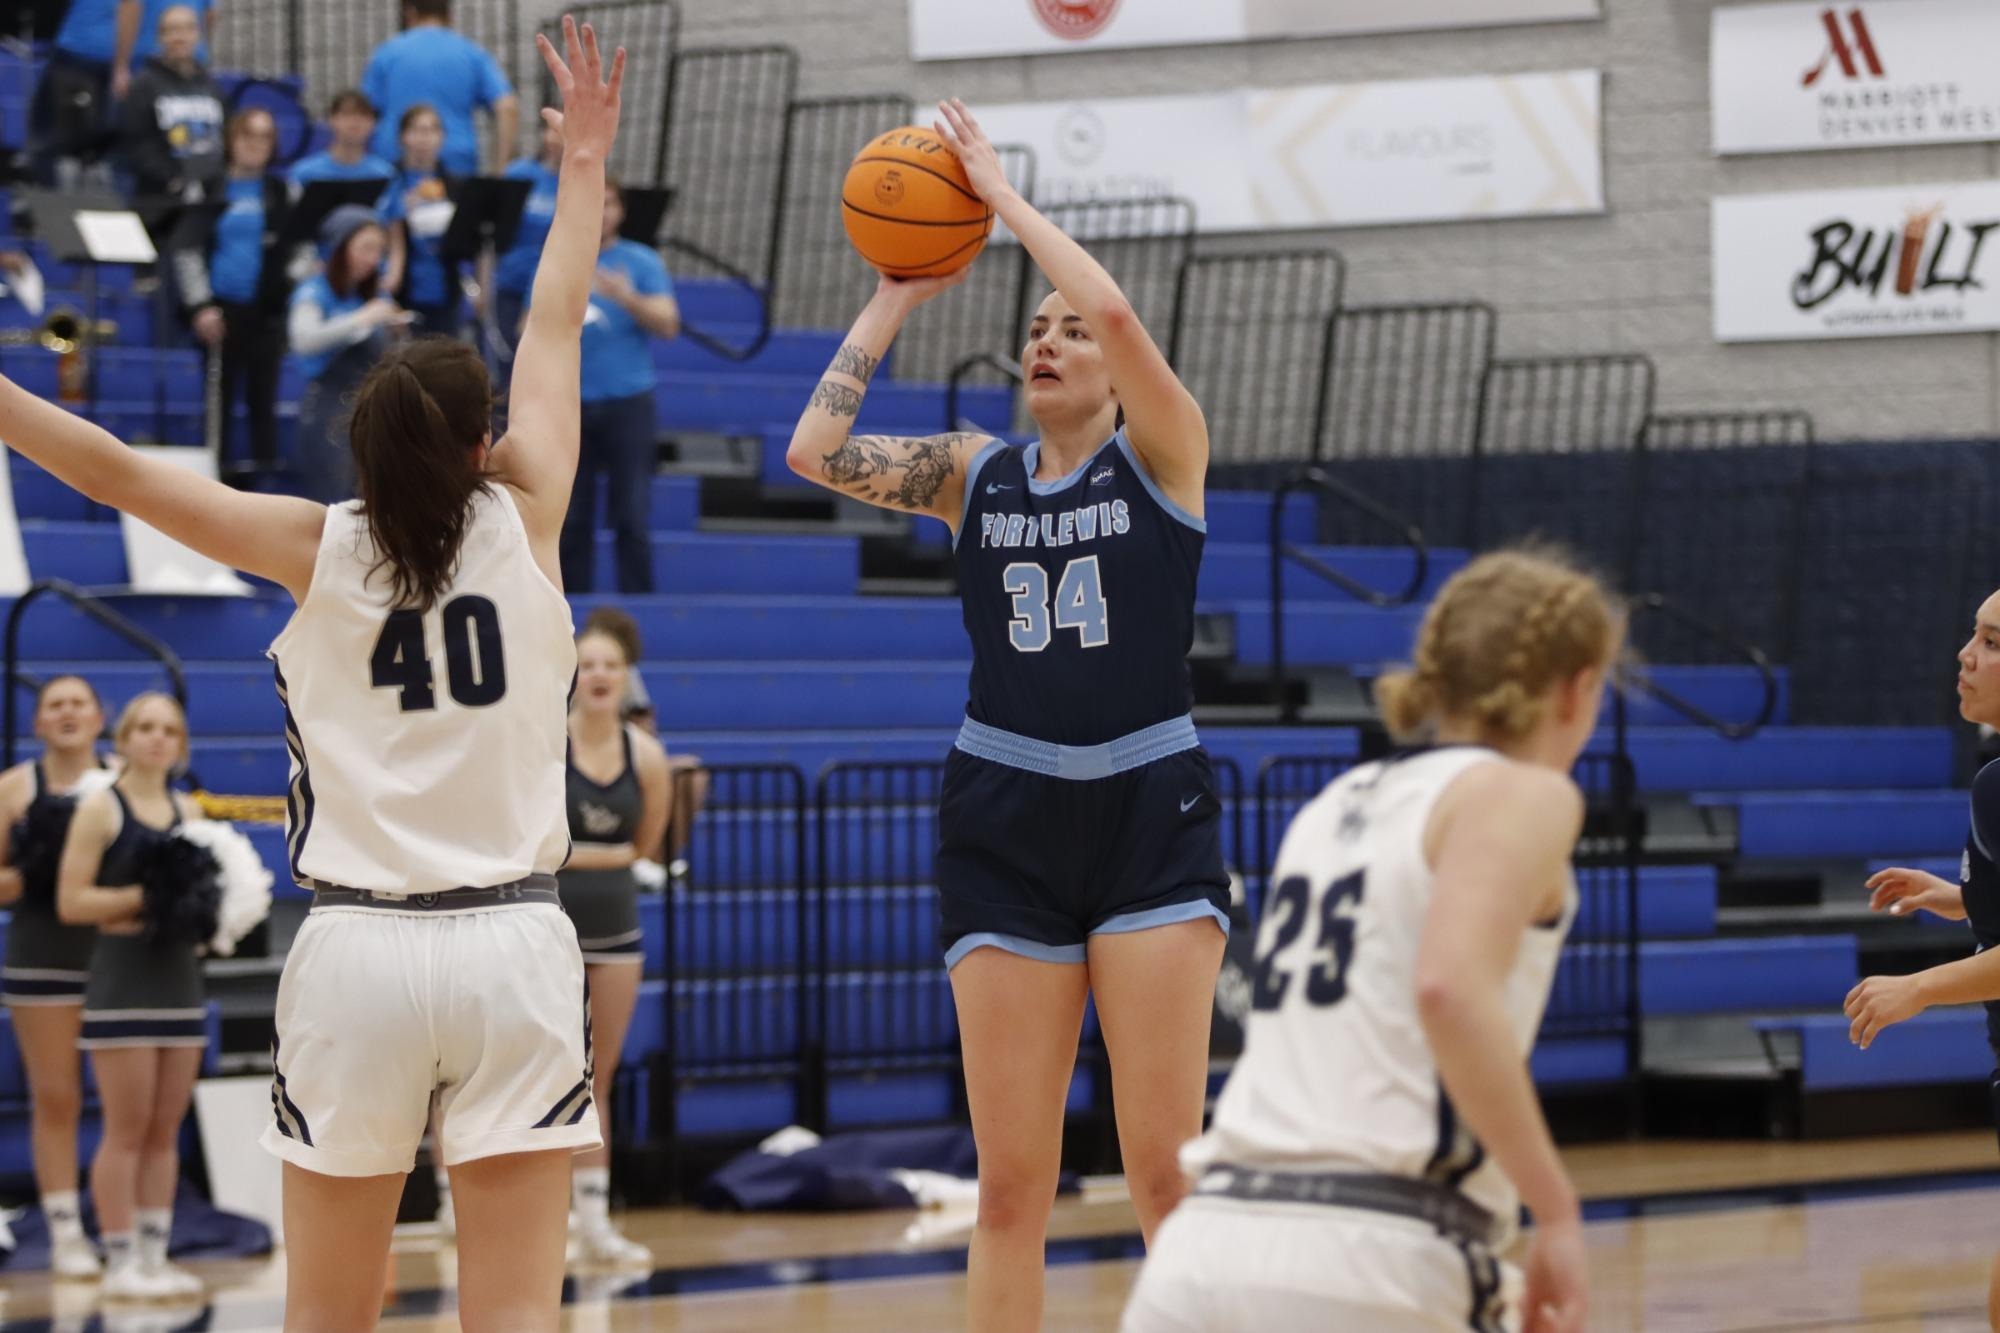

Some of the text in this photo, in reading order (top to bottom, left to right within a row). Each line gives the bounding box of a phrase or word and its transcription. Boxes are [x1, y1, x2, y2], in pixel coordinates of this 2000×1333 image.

[1940, 106, 2000, 131] WES
[981, 499, 1131, 548] FORT LEWIS
[1003, 554, 1109, 652] 34
[368, 593, 508, 713] 40
[1252, 867, 1367, 1012] 25
